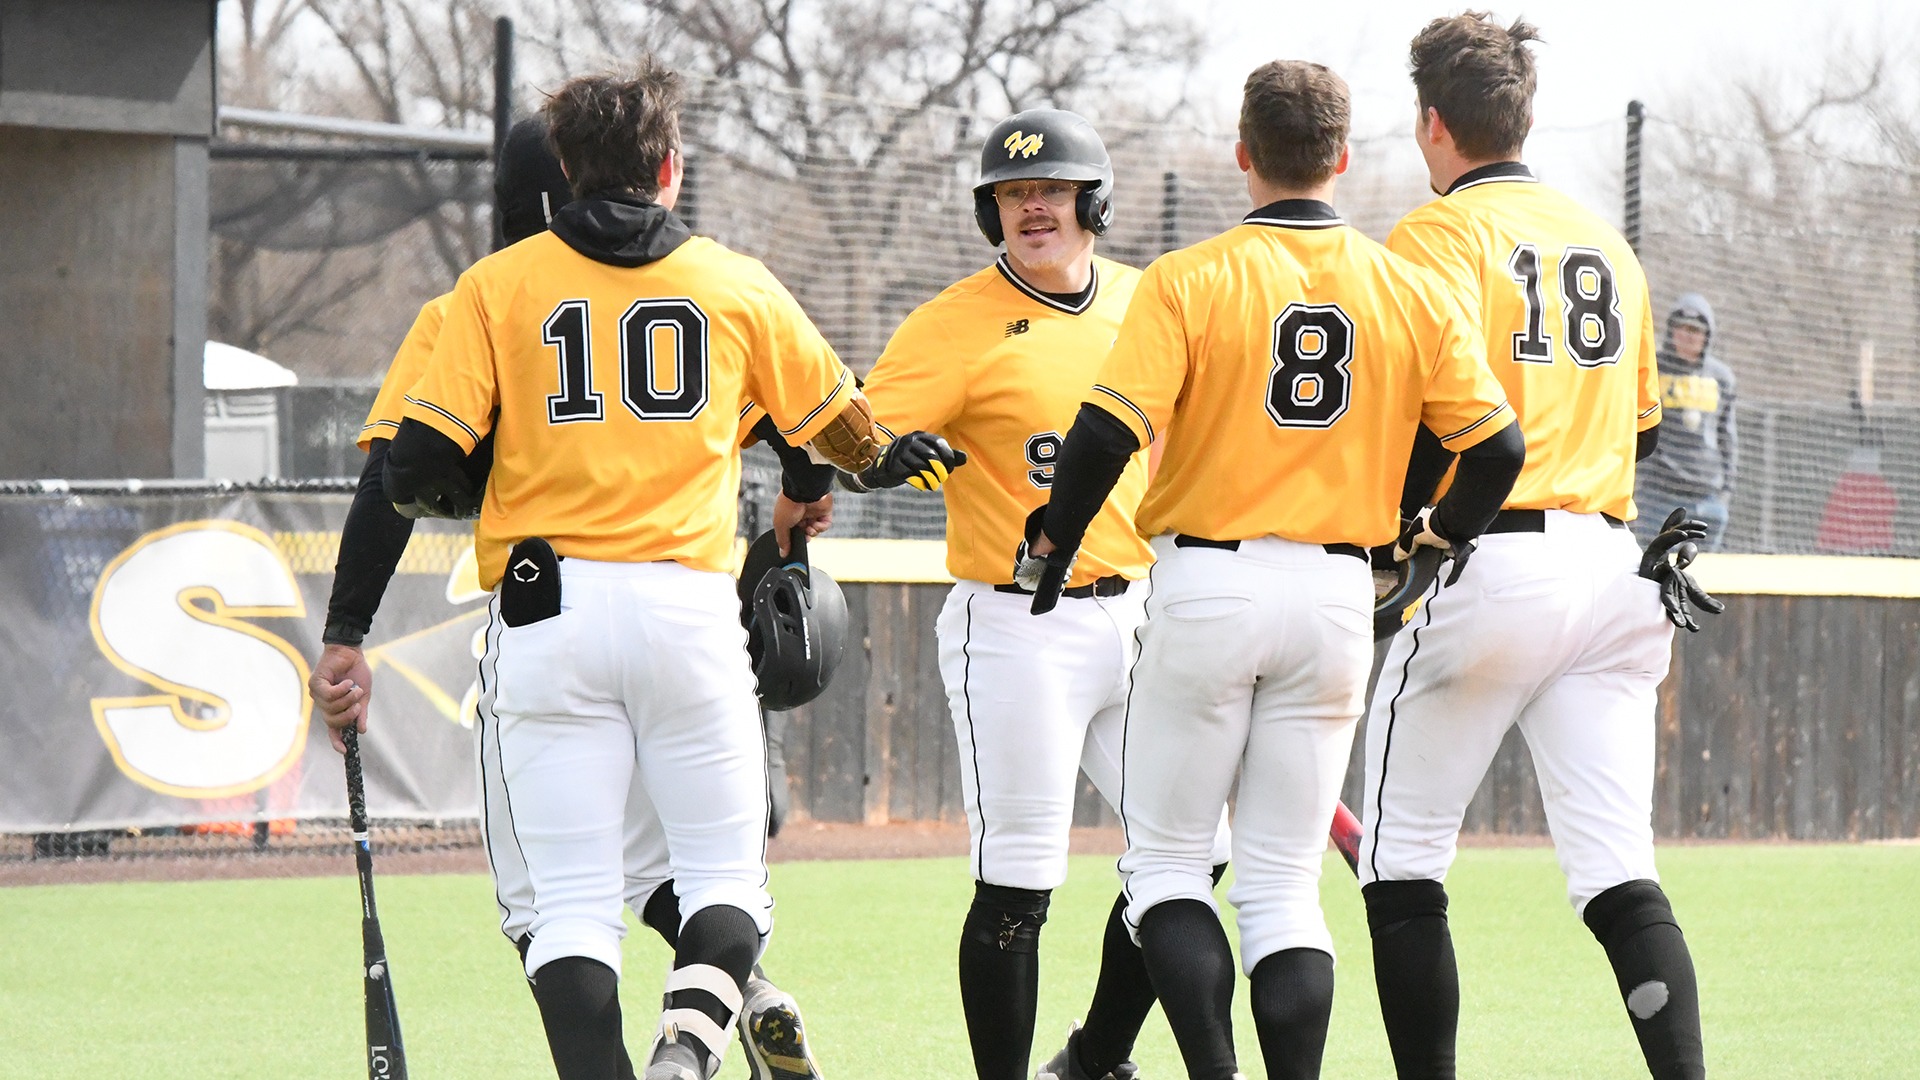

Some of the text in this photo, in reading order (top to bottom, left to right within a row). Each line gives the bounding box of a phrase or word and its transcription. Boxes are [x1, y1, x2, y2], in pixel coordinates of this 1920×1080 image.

[541, 297, 710, 425] 10
[1264, 301, 1356, 430] 8
[1508, 243, 1625, 367] 18
[89, 519, 313, 799] S
[371, 1045, 391, 1080] LO
